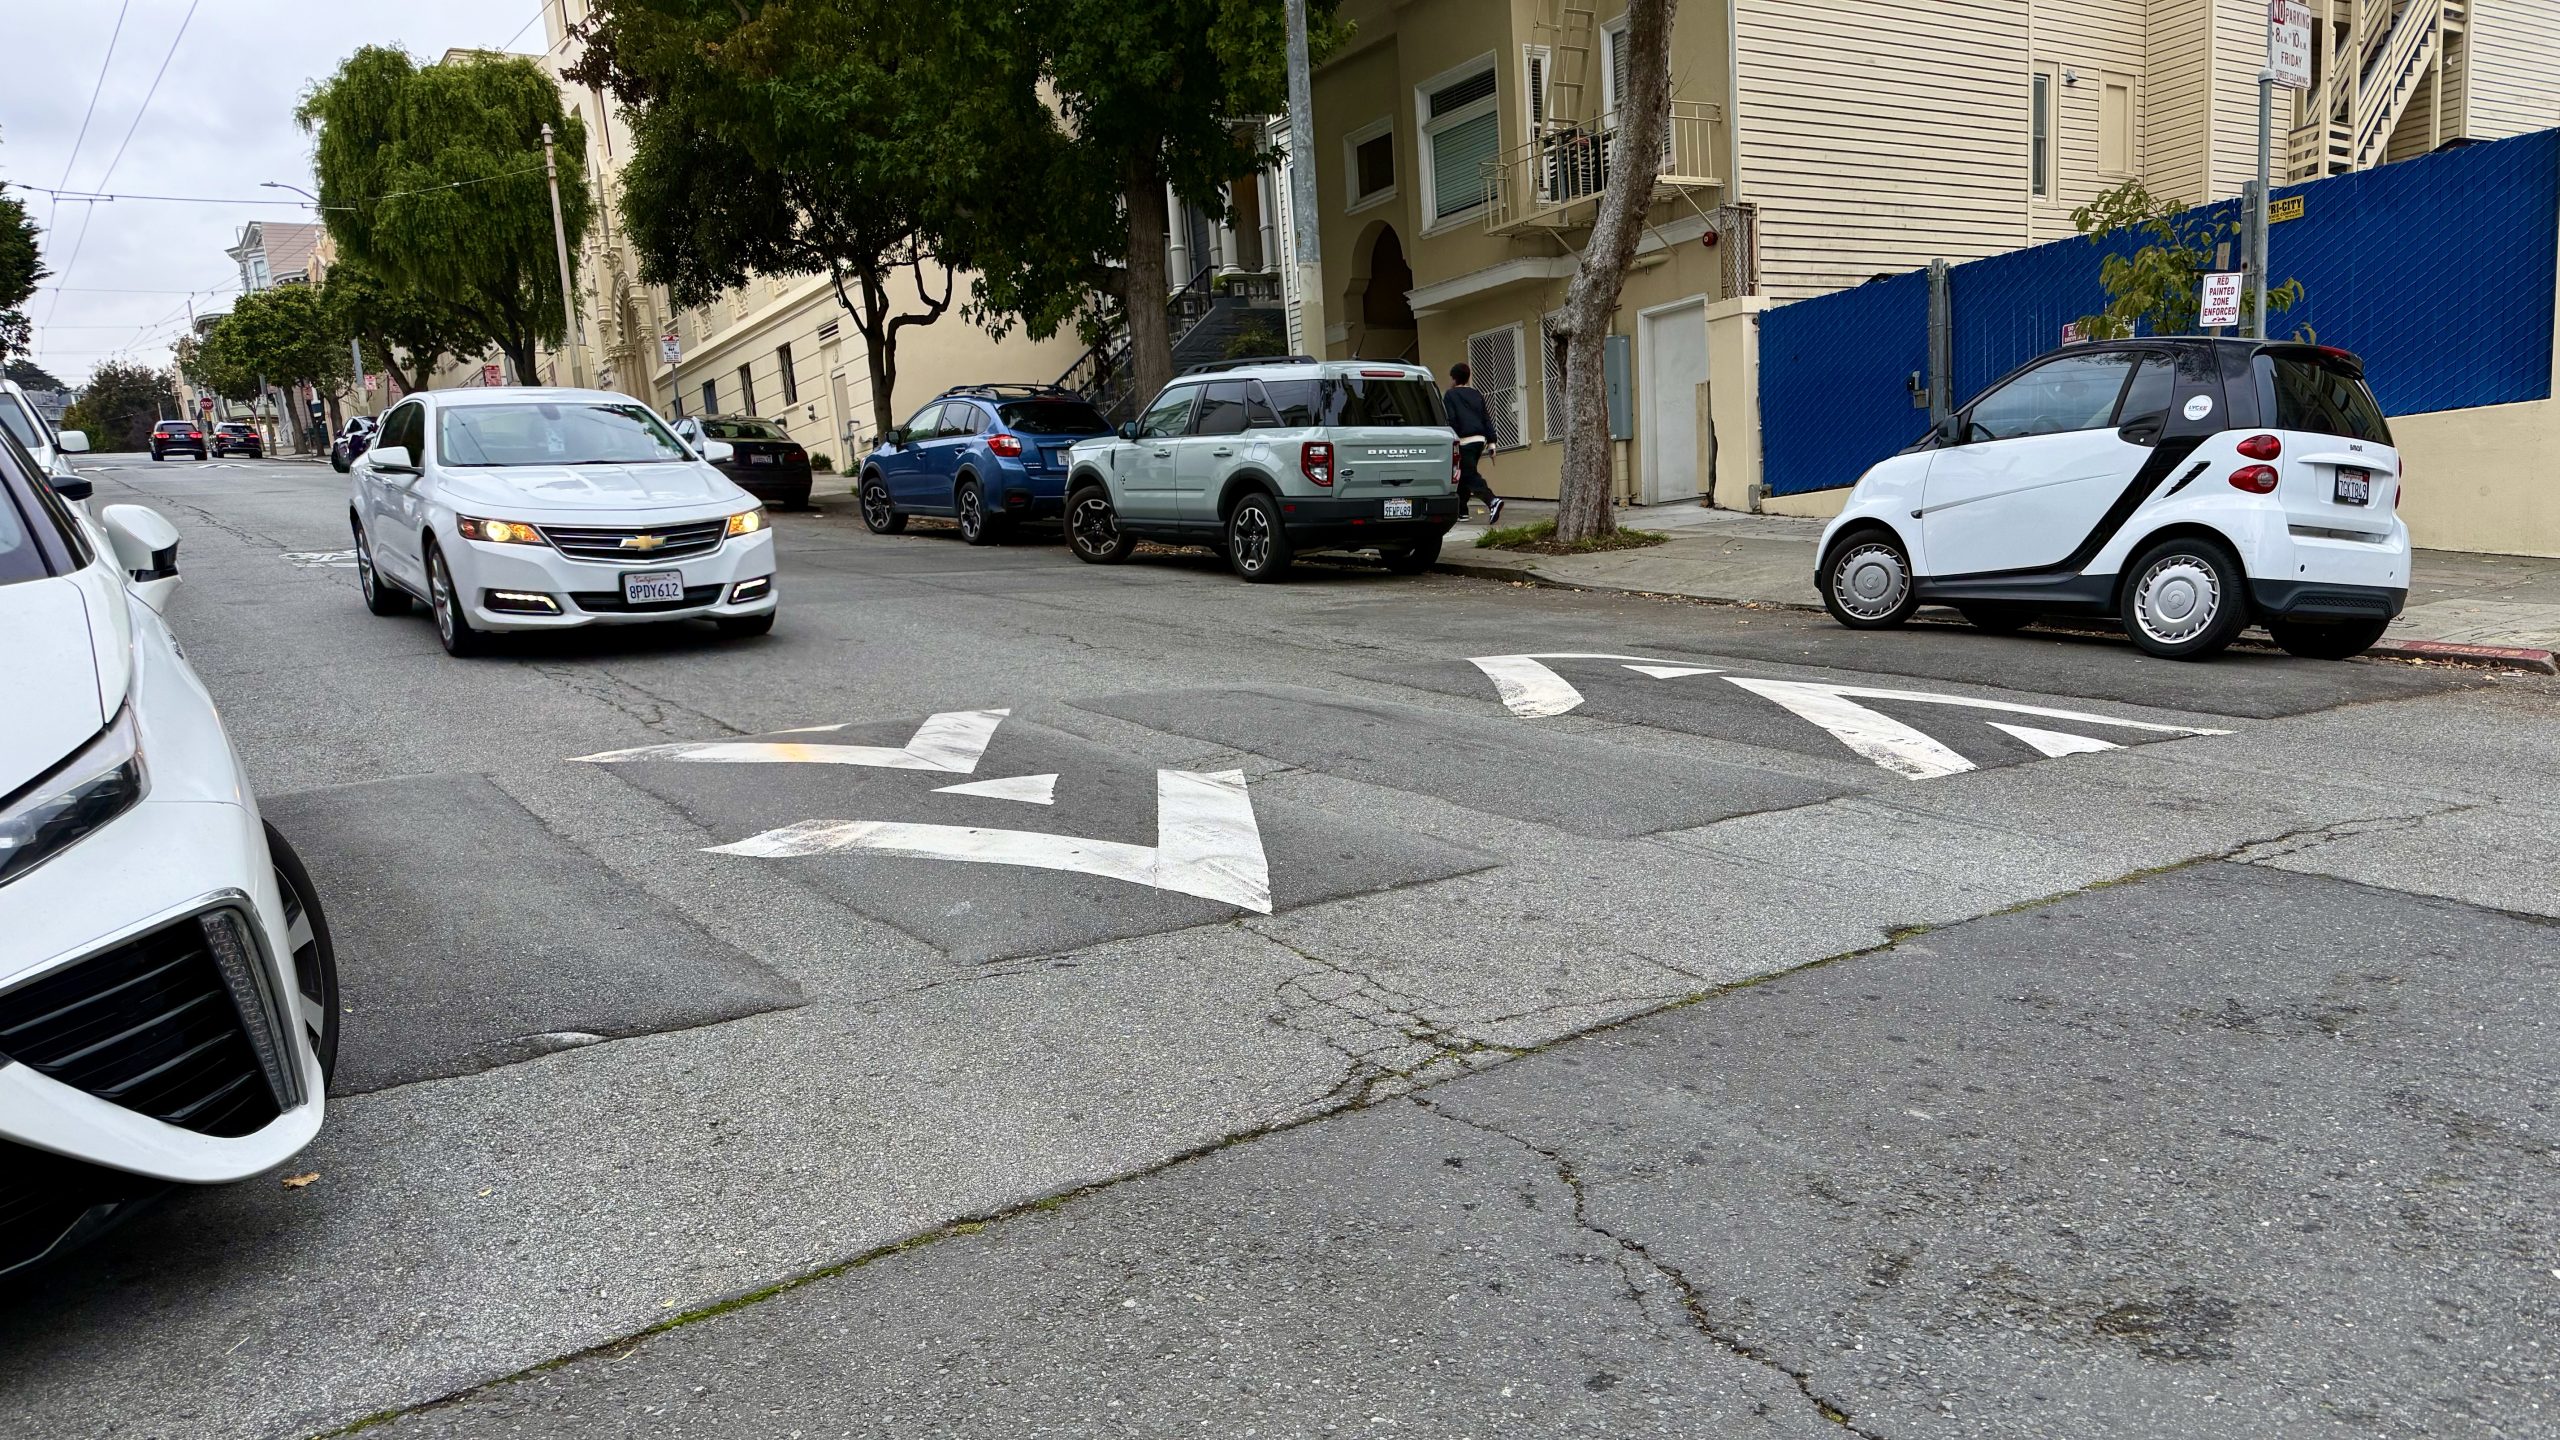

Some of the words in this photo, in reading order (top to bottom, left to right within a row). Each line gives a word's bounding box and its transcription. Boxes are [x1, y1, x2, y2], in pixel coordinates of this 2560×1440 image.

[2273, 0, 2285, 22] NO
[2285, 8, 2309, 29] PARKING
[2276, 27, 2280, 42] 8
[2293, 32, 2299, 48] 10
[2281, 51, 2302, 68] FRIDAY
[2276, 70, 2289, 80] STREET
[2269, 198, 2302, 214] RI-CITY
[2210, 287, 2235, 295] PAINTED
[2213, 297, 2229, 306] ZONE
[2204, 307, 2236, 316] ENFORCED
[630, 582, 680, 599] 8PDY612
